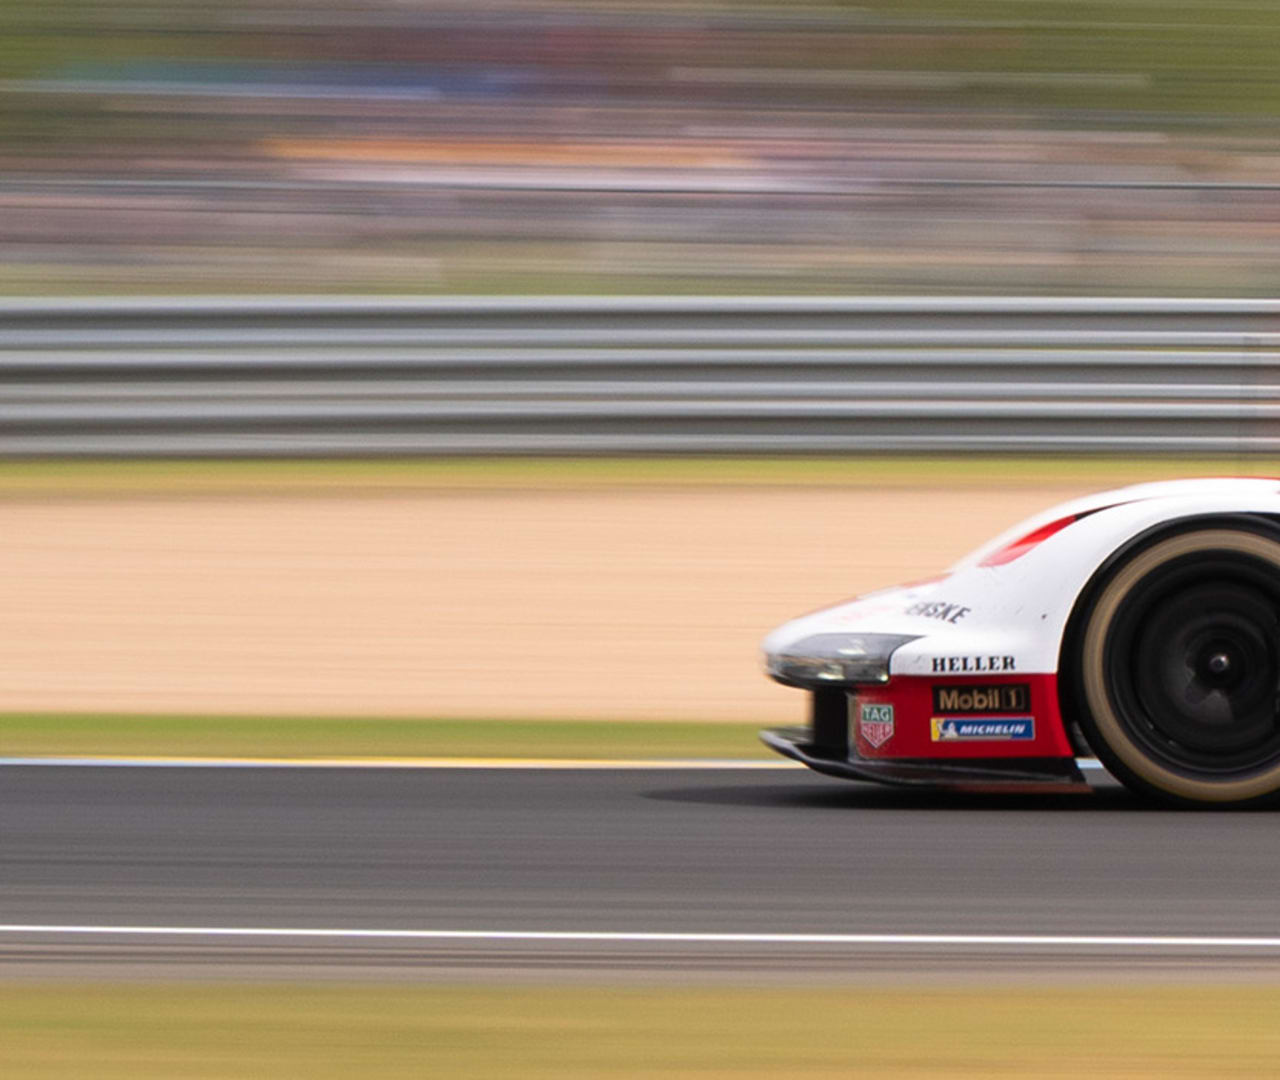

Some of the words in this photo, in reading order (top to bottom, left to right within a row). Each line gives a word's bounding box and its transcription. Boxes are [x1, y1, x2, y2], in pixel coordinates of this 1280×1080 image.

[931, 655, 1016, 673] HELLER
[939, 689, 1000, 710] Mobil
[864, 707, 890, 721] TAG
[960, 724, 1025, 735] MICHELIN
